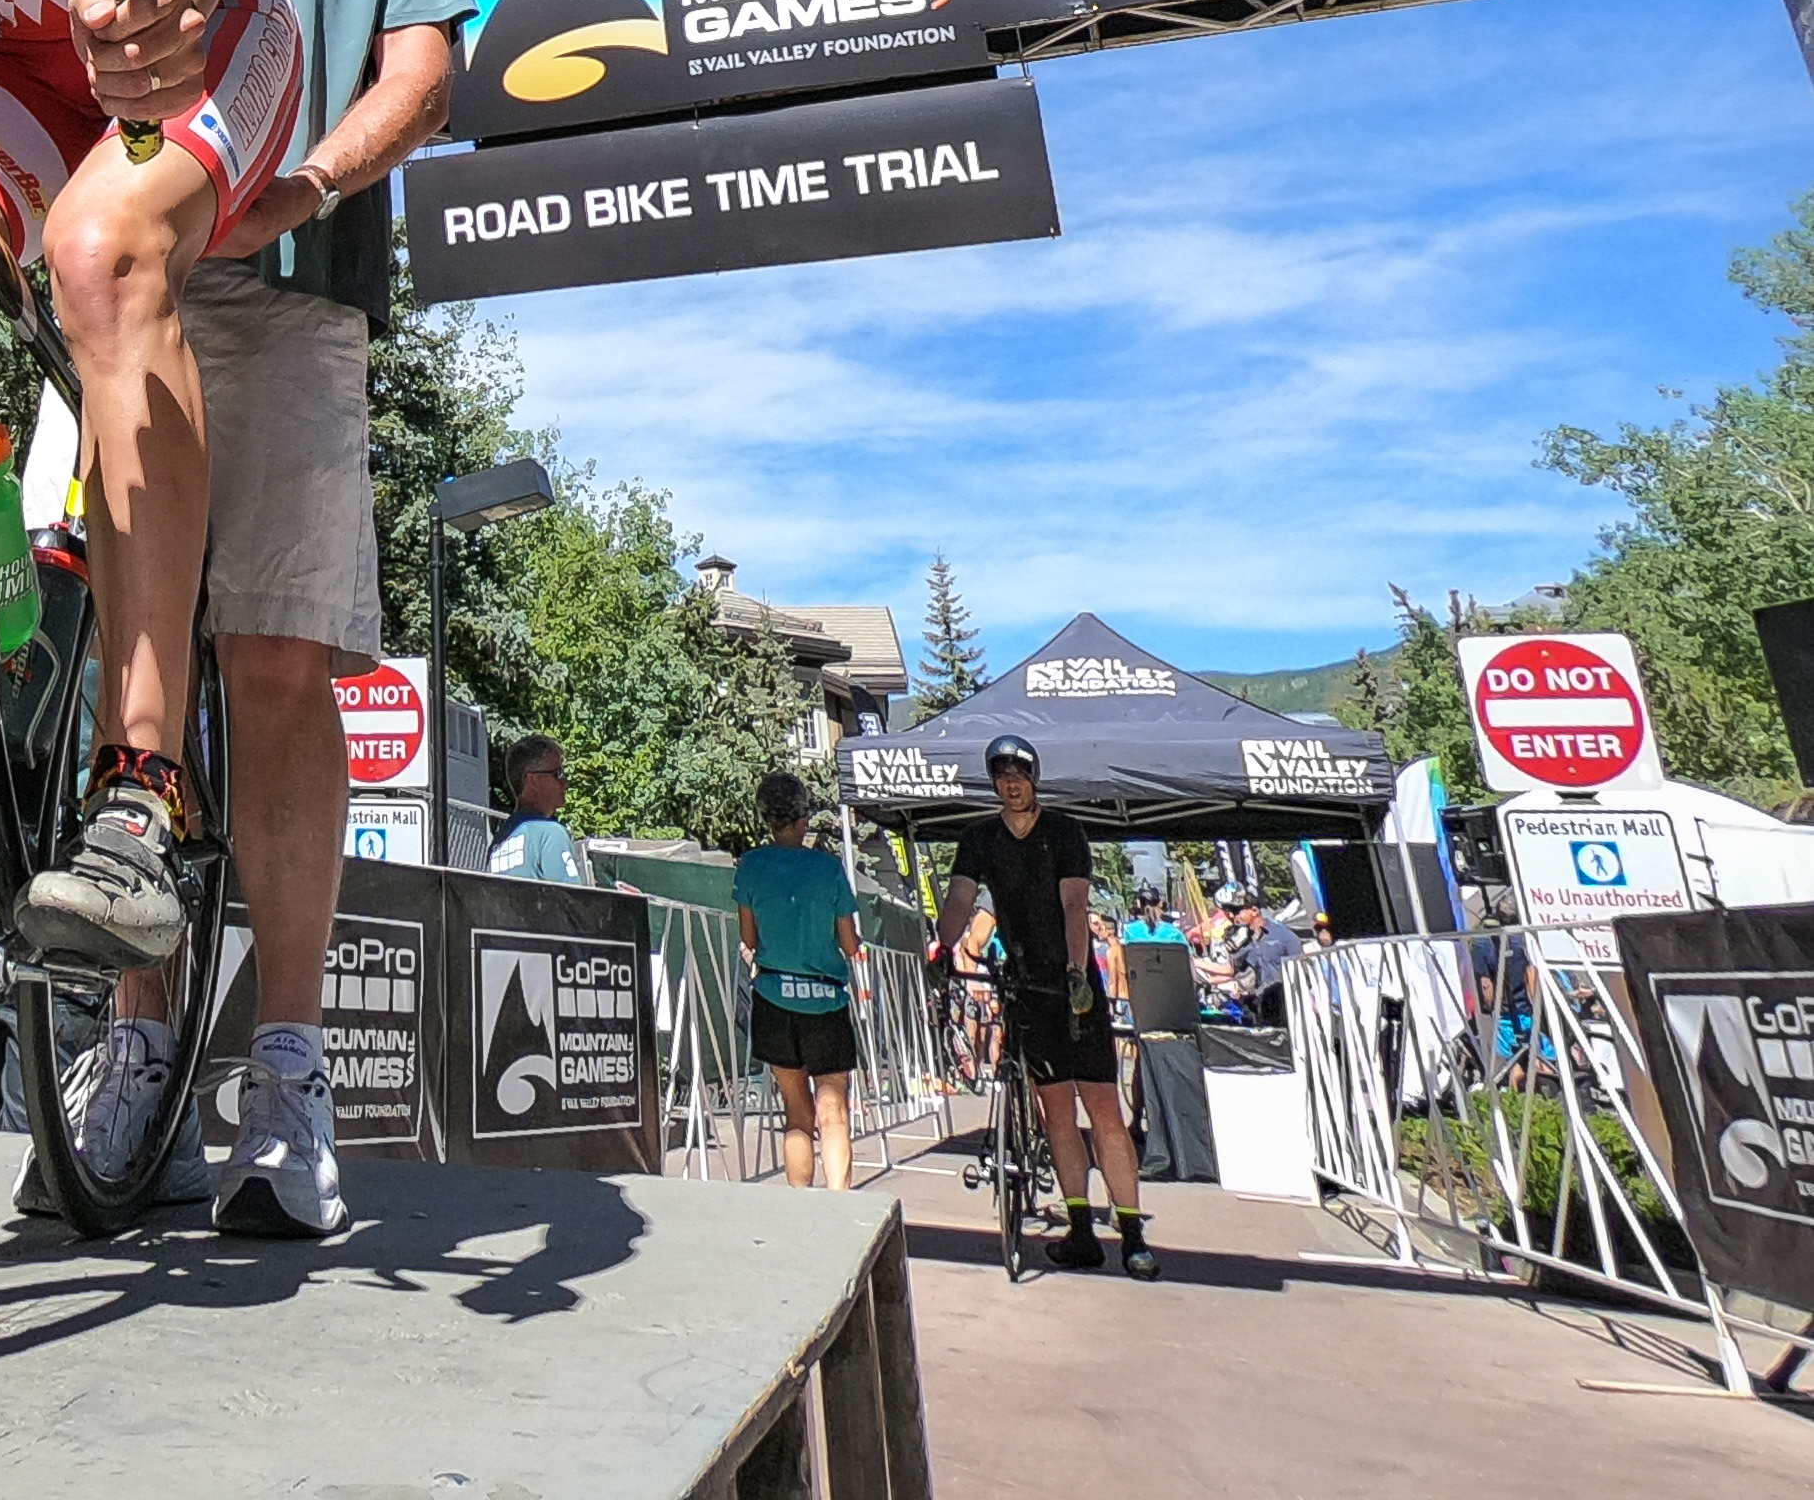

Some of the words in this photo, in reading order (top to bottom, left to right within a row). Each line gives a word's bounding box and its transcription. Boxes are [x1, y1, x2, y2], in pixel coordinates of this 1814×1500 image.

[703, 53, 746, 72] VAIL
[747, 43, 818, 66] VALLEY
[823, 25, 956, 57] FOUNDATION
[444, 197, 570, 244] ROAD
[584, 179, 693, 228] BIKE
[705, 160, 829, 211] TIME
[843, 141, 999, 194] TRIAL
[1026, 678, 1176, 691] FOUNDATION
[1486, 668, 1535, 692] DO
[1544, 666, 1613, 691] NOT
[368, 685, 412, 706] NOT
[347, 740, 407, 760] NTER
[880, 747, 927, 766] VAIL
[1274, 740, 1330, 759] VAIL
[1510, 734, 1624, 759] ENTER
[882, 764, 959, 784] VALLEY
[1279, 759, 1368, 778] VALLEY
[1249, 778, 1374, 795] FOUNDATION
[347, 810, 389, 825] strian
[392, 810, 418, 825] Mall
[1514, 818, 1618, 836] Pedestrian
[1623, 818, 1666, 837] Mall
[1530, 888, 1554, 905] No
[1558, 888, 1684, 908] Unauthorized
[1579, 940, 1612, 958] his
[556, 954, 632, 987] GoPro
[1746, 995, 1814, 1036] GoP
[559, 1032, 628, 1052] MOUNTAIN
[561, 1056, 631, 1085] GAMES
